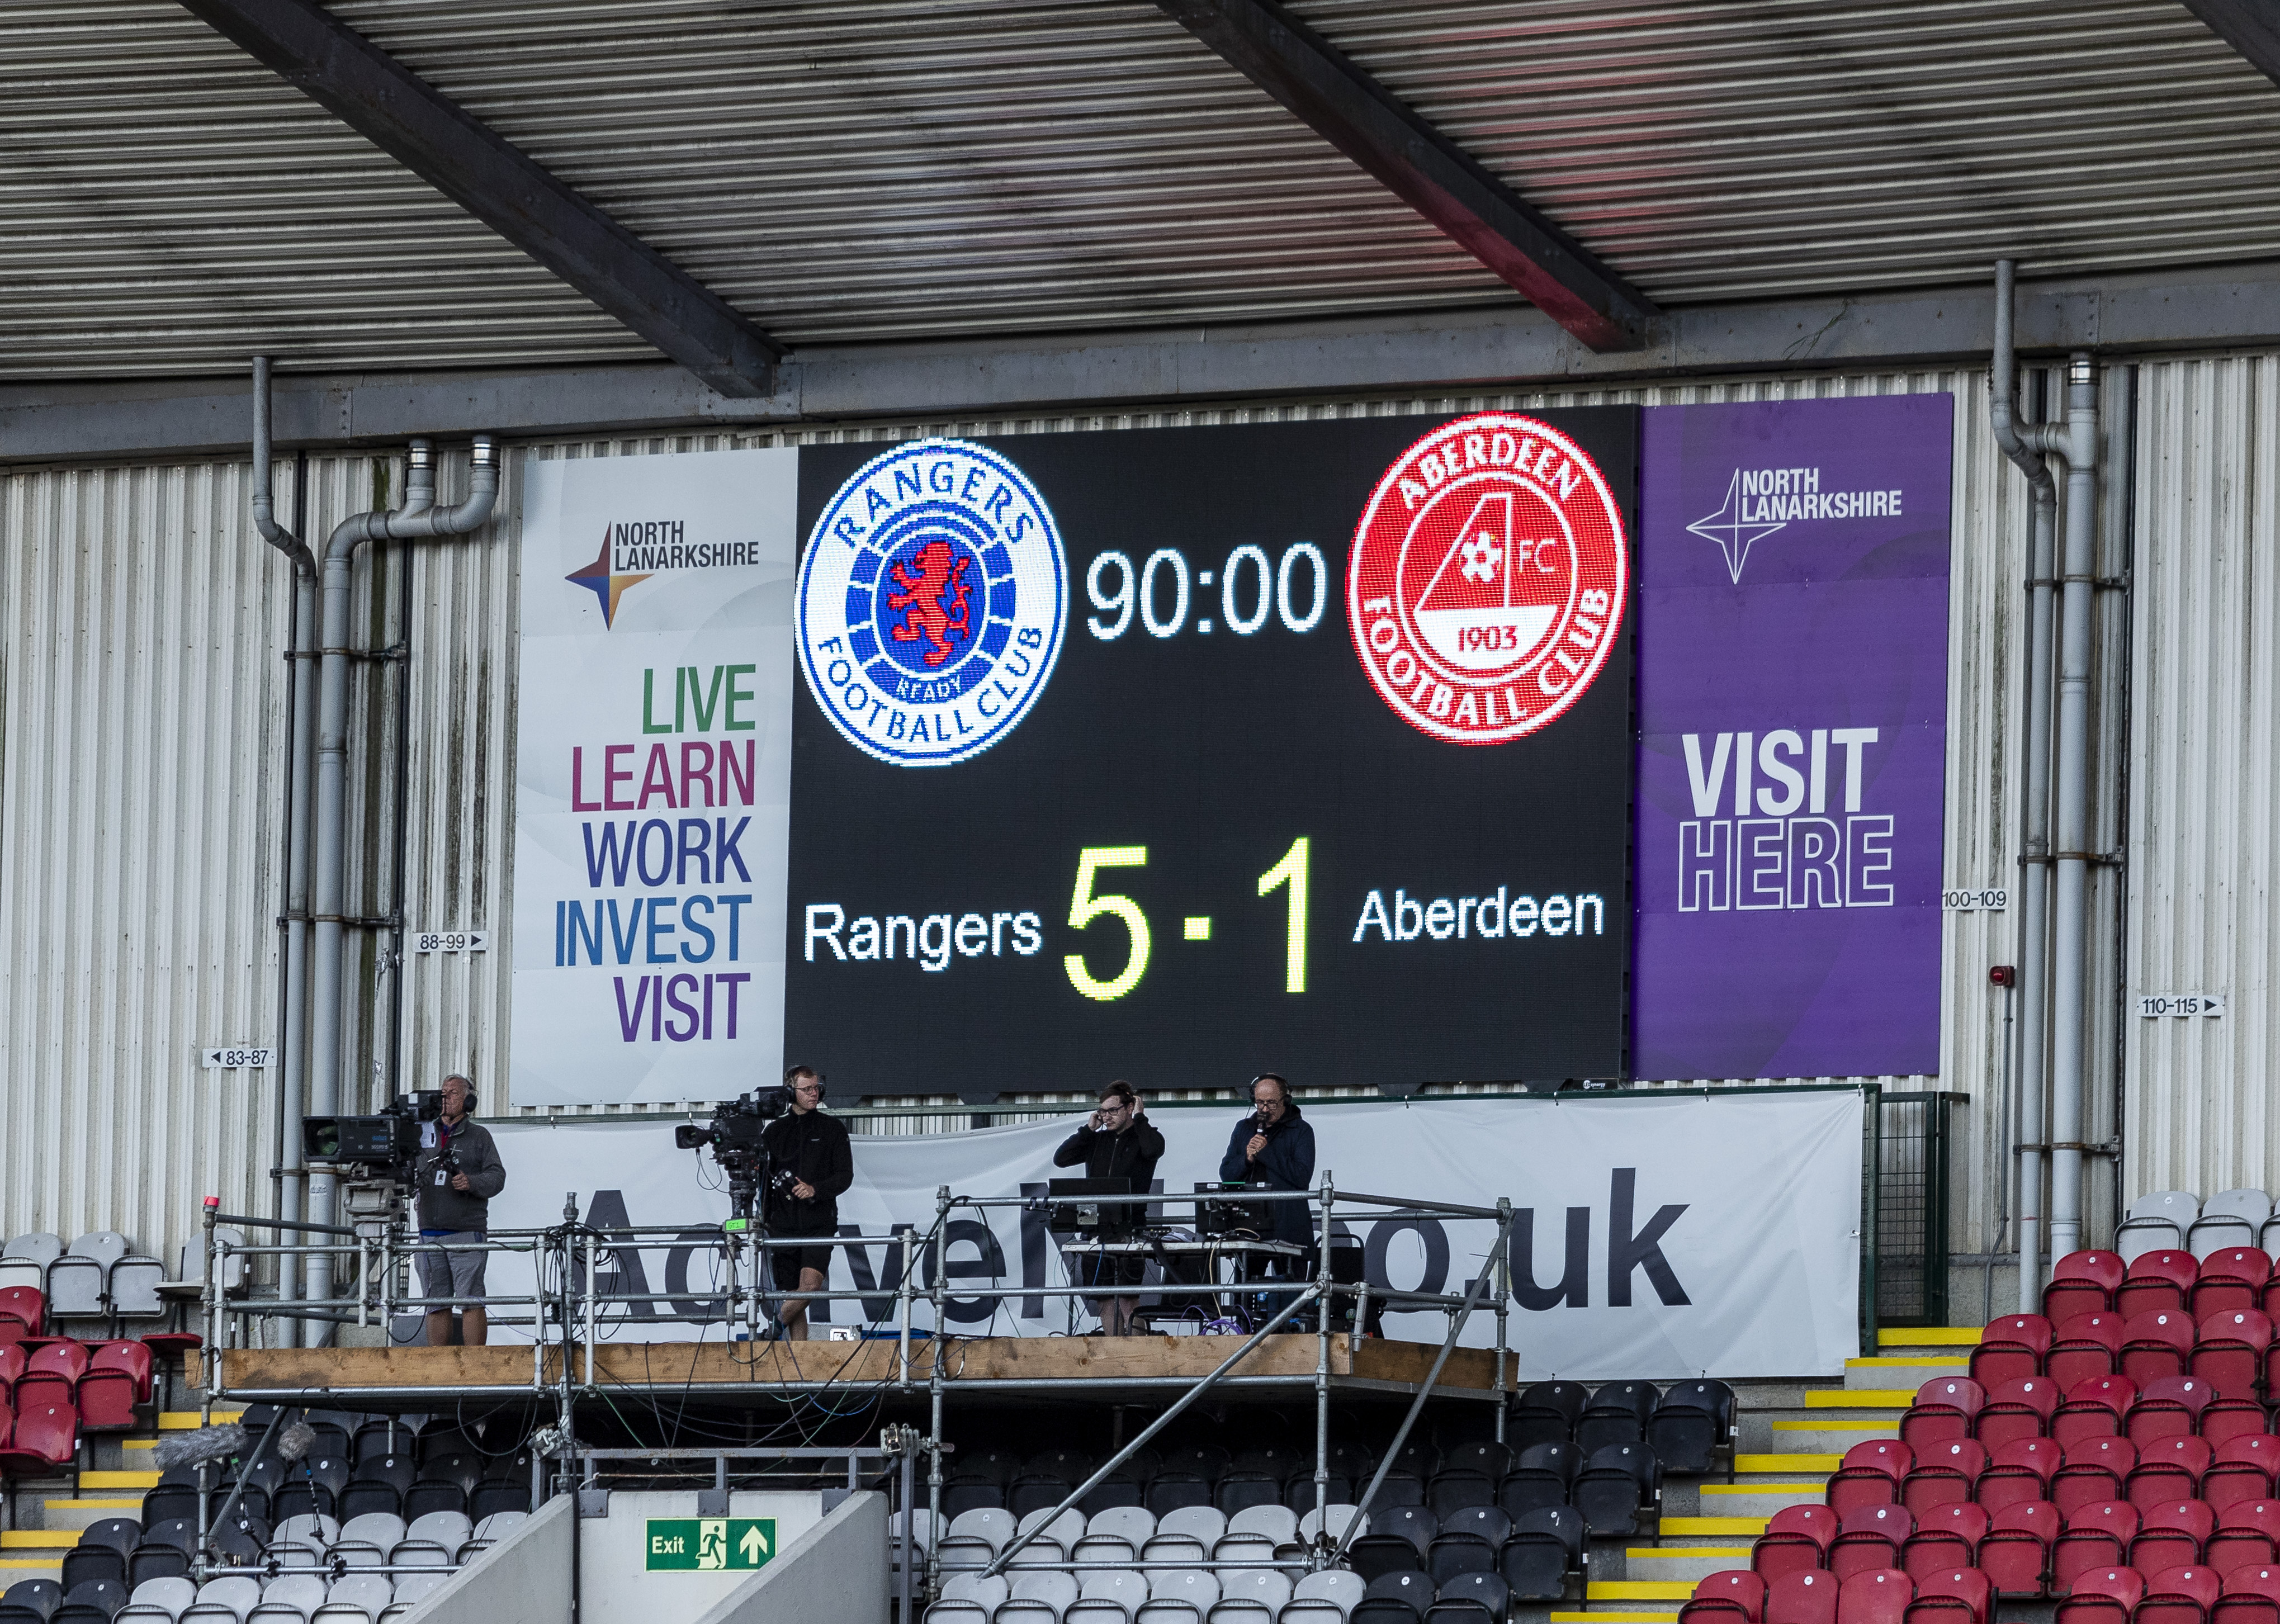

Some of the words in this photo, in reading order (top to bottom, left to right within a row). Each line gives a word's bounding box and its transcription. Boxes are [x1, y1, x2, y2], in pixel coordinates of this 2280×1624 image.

[834, 462, 1034, 548] RANGERS
[1400, 433, 1581, 509] ABERDEEN
[1742, 468, 1819, 496] NORTH
[616, 520, 683, 546] NORTH
[1742, 490, 1901, 522] LANARKSHIRE
[615, 542, 759, 571] LANARKSHIRE
[1519, 539, 1555, 573] FC
[1087, 543, 1327, 641] 90:00
[1364, 596, 1528, 726] FOOTBALL
[1538, 589, 1609, 697] CLUB
[1458, 626, 1518, 652] 1903
[642, 664, 756, 734] LIVE
[819, 637, 973, 742] FOOTBALL
[979, 628, 1042, 716] CLUB
[572, 740, 755, 812] LEARN
[1682, 728, 1878, 817] VISIT
[582, 816, 752, 888] WORK
[1678, 815, 1894, 912] HERE
[556, 894, 752, 966] INVEST
[805, 903, 1042, 972] Rangers
[1063, 845, 1150, 1001] 5
[1257, 837, 1309, 993] 1
[1352, 886, 1604, 943] Aberdeen
[1942, 891, 2006, 907] 100-109
[420, 934, 465, 949] 88-99
[613, 973, 750, 1042] VISIT
[2142, 998, 2197, 1014] 110-115
[226, 1050, 268, 1065] 83-87
[652, 1536, 684, 1554] Exit
